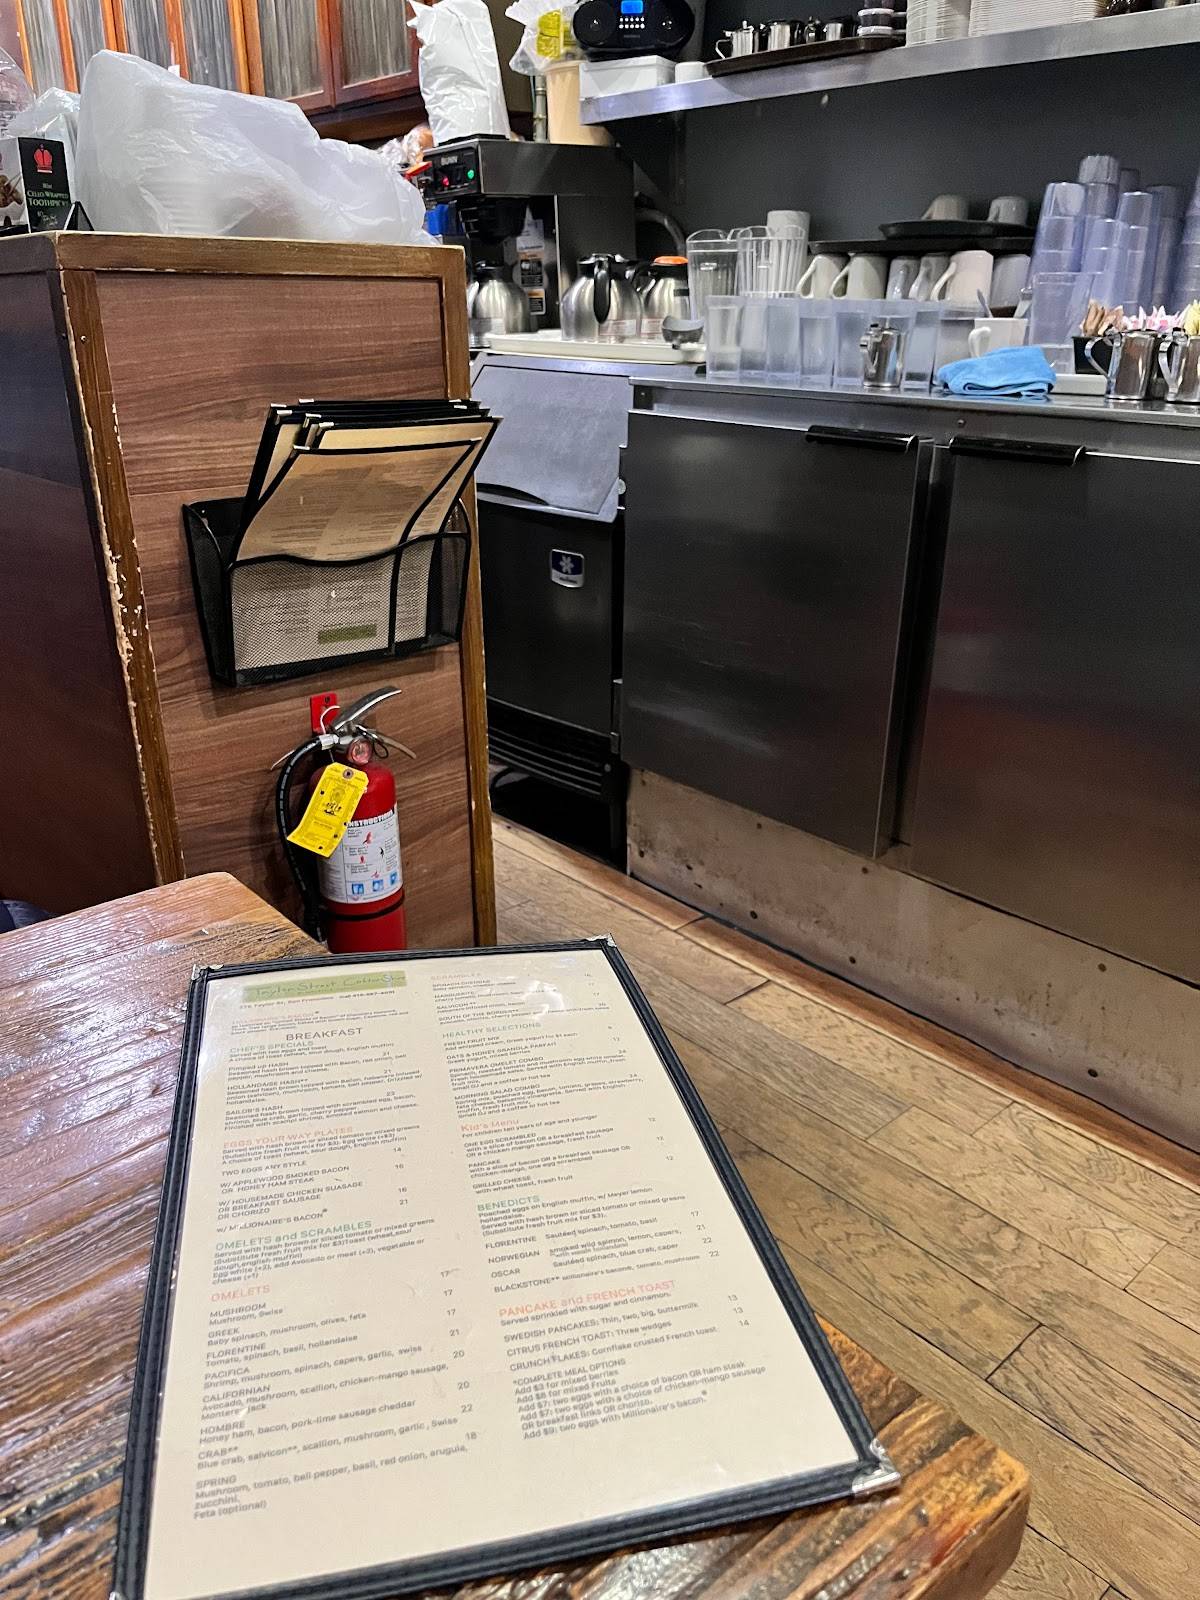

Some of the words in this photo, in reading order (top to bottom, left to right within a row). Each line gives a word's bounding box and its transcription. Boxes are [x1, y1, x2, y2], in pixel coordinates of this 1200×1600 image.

[286, 1027, 363, 1040] BREAKFAST
[441, 1028, 483, 1038] HEALTHY
[486, 1022, 542, 1032] SELECTIONS
[223, 1139, 252, 1148] EGGS
[255, 1135, 284, 1144] YOUR
[287, 1132, 311, 1140] WAY
[232, 1174, 284, 1186] APPLEWOOD
[286, 1169, 319, 1178] SMOKED
[321, 1165, 349, 1173] BACON
[237, 1183, 265, 1191] HONEY
[232, 1199, 280, 1210] BREAKFAST
[283, 1193, 320, 1203] SAUSAGE
[476, 1195, 540, 1210] BENEDICTS
[231, 1207, 269, 1217] CHORIZO
[215, 1235, 271, 1250] OMELETS
[275, 1232, 297, 1241] and
[300, 1221, 372, 1238] SCRAMBLES
[485, 1235, 536, 1248] FLORENTINE
[488, 1250, 540, 1263] NORWEGIAN
[490, 1267, 520, 1278] OSCAR
[211, 1285, 270, 1302] OMELETS
[498, 1300, 557, 1317] PANCAKE
[560, 1296, 583, 1306] and
[585, 1287, 636, 1302] FRENCH
[638, 1280, 675, 1293] TOAST
[209, 1313, 256, 1325] Mushroom,
[259, 1308, 283, 1317] Swiss
[210, 1302, 266, 1317] MUSHROOM
[500, 1315, 529, 1326] Served
[530, 1308, 568, 1321] sprinkled
[570, 1305, 588, 1313] with
[629, 1292, 671, 1302] cinnamon.
[503, 1328, 546, 1342] SWEDISH
[547, 1319, 600, 1334] PANCAKES:
[600, 1316, 622, 1324] Thin,
[656, 1301, 698, 1314] buttermilk
[207, 1337, 229, 1345] Baby
[231, 1330, 268, 1342] spinach,
[270, 1322, 318, 1334] mushroom,
[320, 1317, 347, 1325] olives,
[208, 1327, 238, 1338] GREEK
[506, 1344, 541, 1356] CITRUS
[542, 1336, 580, 1350] FRENCH
[581, 1330, 614, 1342] TOAST:
[615, 1327, 640, 1336] Three
[640, 1321, 672, 1331] wedges
[206, 1342, 266, 1358] FLORENTINE
[206, 1356, 241, 1366] Tomato,
[244, 1348, 280, 1360] spinach,
[283, 1343, 306, 1353] basil,
[308, 1335, 357, 1348] hollandaise
[452, 1350, 464, 1358] 20
[509, 1356, 551, 1371] CRUNCH
[551, 1350, 590, 1363] FLAKES:
[590, 1342, 632, 1355] Cornflake
[632, 1335, 665, 1347] crusted
[665, 1329, 695, 1341] French
[695, 1325, 717, 1335] toast
[205, 1366, 250, 1380] PACIFICA
[563, 1365, 587, 1375] MEAL
[588, 1358, 626, 1371] OPTIONS
[202, 1398, 244, 1411] Avocado,
[246, 1390, 298, 1403] mushroom,
[300, 1382, 337, 1393] scallion,
[339, 1370, 408, 1386] chicken-mango
[410, 1364, 449, 1374] sausage,
[457, 1380, 470, 1389] 20
[517, 1402, 535, 1412] Add
[570, 1393, 591, 1402] eggs
[592, 1387, 612, 1397] with
[620, 1381, 650, 1391] choice
[660, 1373, 688, 1383] bacon
[688, 1369, 702, 1377] OR
[702, 1366, 722, 1374] ham
[722, 1360, 746, 1370] steak
[202, 1384, 270, 1402] CALIFORNIAN
[460, 1403, 473, 1412] 22
[200, 1433, 230, 1443] Honey
[232, 1429, 254, 1438] ham,
[258, 1423, 289, 1433] bacon,
[291, 1414, 336, 1429] pork-lime
[339, 1408, 376, 1419] sausage
[378, 1400, 415, 1412] cheddar
[200, 1420, 245, 1435] HOMBRE
[465, 1431, 478, 1440] 18
[196, 1474, 236, 1489] SPRING
[194, 1509, 216, 1520] Feta
[218, 1498, 266, 1517] (optional)
